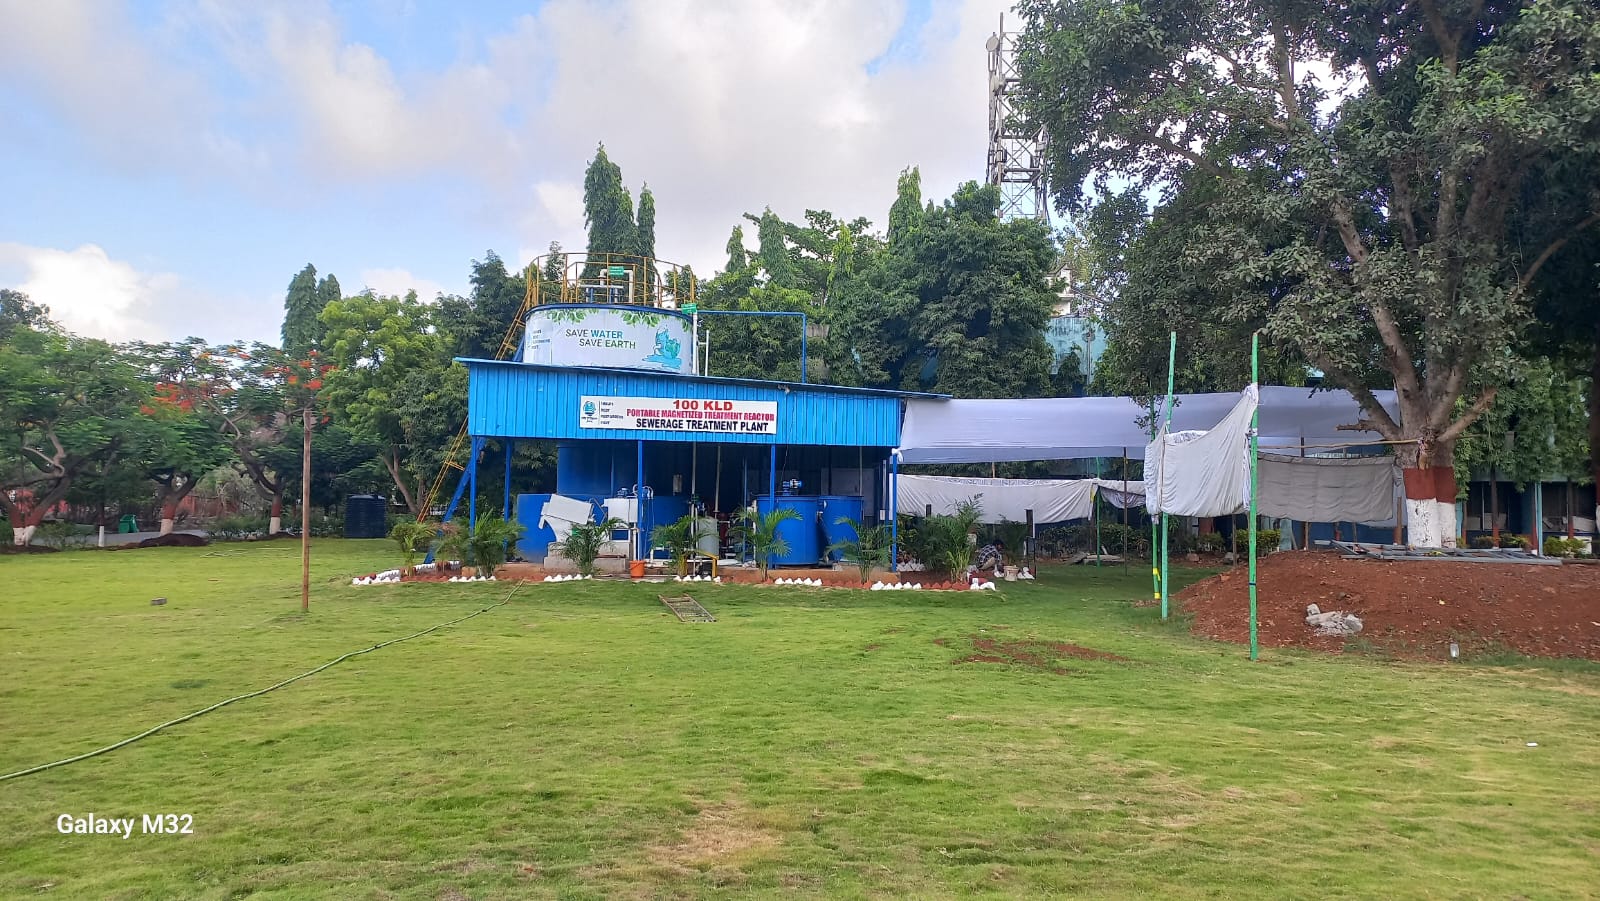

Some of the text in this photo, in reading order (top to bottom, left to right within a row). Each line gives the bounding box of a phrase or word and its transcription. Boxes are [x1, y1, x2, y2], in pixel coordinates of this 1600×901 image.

[565, 329, 623, 339] SAVE WATER
[579, 338, 636, 349] SAVE EARTH
[673, 400, 733, 411] 100 KLD
[626, 409, 660, 418] PORTABLE
[661, 410, 703, 419] MAGNETIZED
[704, 411, 743, 420] TREATMENT
[744, 412, 775, 421] REACTOR
[636, 418, 769, 432] SEWERAGE TREATMENT PLANT
